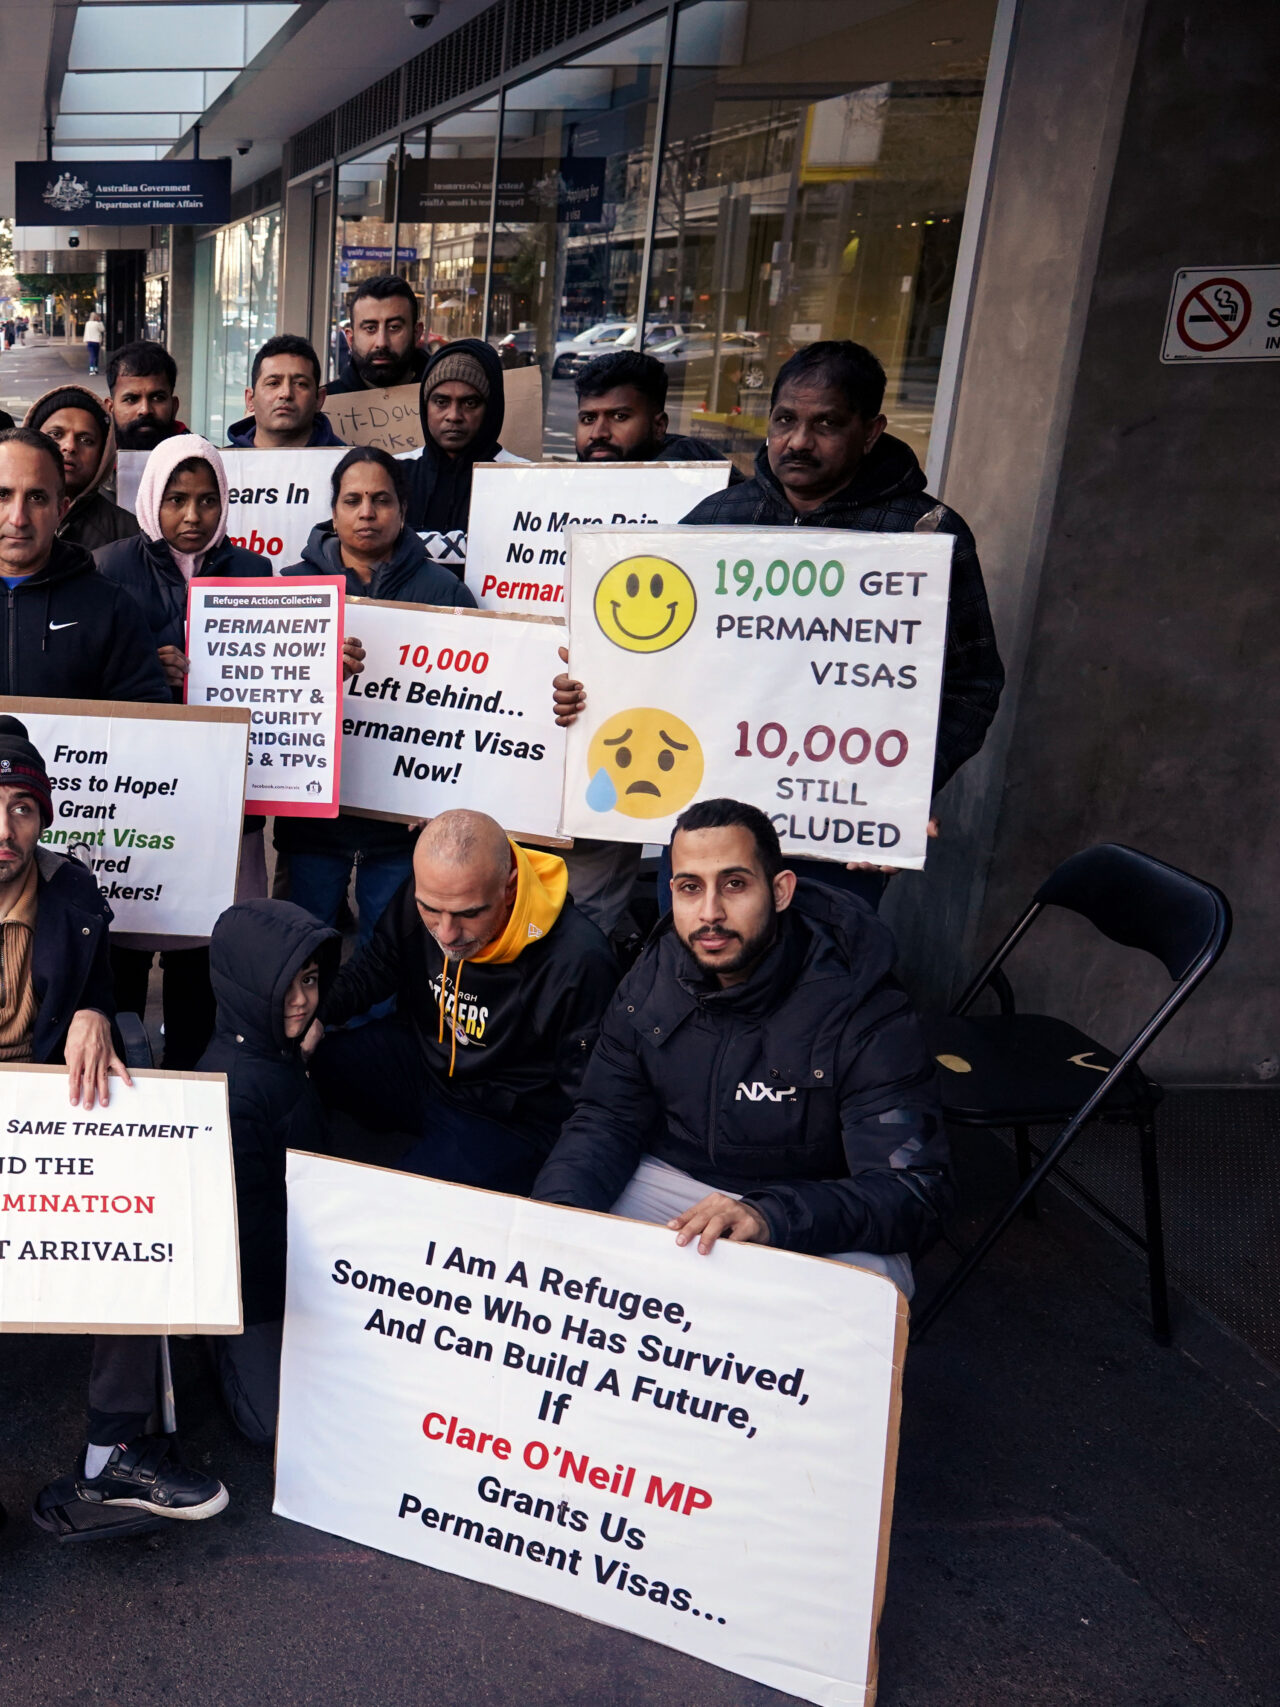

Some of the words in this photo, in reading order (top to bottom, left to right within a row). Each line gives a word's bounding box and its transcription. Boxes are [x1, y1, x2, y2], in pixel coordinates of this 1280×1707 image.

[95, 184, 138, 193] Australian
[140, 184, 191, 193] Government
[95, 200, 141, 210] Department
[142, 200, 151, 209] of
[152, 200, 175, 209] Home
[177, 200, 204, 209] Affairs
[286, 482, 309, 504] In
[512, 511, 542, 532] No
[506, 543, 535, 564] No
[714, 558, 845, 602] 19,000
[859, 571, 929, 597] GET
[213, 597, 250, 606] Refugee
[251, 596, 280, 605] Action
[280, 596, 323, 605] Collective
[204, 619, 332, 635] PERMANENT
[716, 614, 923, 645] PERMANENT
[207, 642, 267, 657] VISAS
[272, 642, 327, 657] NOW!
[399, 643, 490, 675] 10,000
[221, 665, 264, 680] END
[271, 666, 311, 681] THE
[810, 661, 919, 690] VISAS
[206, 687, 304, 703] POVERTY
[310, 689, 325, 704] &
[348, 675, 401, 703] Left
[406, 681, 524, 717] Behind...
[53, 745, 109, 765] From
[474, 729, 547, 761] Visas
[734, 720, 909, 768] 10,000
[260, 753, 274, 767] &
[280, 754, 327, 768] TPVs
[392, 755, 463, 785] Now!
[88, 775, 109, 793] to
[114, 775, 179, 799] Hope!
[775, 777, 869, 806] STILL
[58, 800, 117, 820] Grant
[113, 828, 176, 850] Visas
[766, 811, 901, 848] CLUDED
[6, 1119, 66, 1136] SAME
[73, 1121, 199, 1140] TREATMENT
[35, 1157, 95, 1176] THE
[18, 1240, 175, 1263] ARRIVALS!
[424, 1241, 437, 1266] I
[443, 1246, 497, 1281] Am
[505, 1262, 530, 1289] A
[540, 1269, 694, 1333] Refugee,
[331, 1259, 473, 1315] Someone
[482, 1296, 553, 1335] Who
[560, 1315, 628, 1355] Has
[637, 1336, 812, 1406] Survived,
[364, 1308, 427, 1345] And
[433, 1326, 494, 1363] Can
[502, 1342, 589, 1387] Build
[594, 1368, 621, 1397] A
[631, 1377, 760, 1440] Future,
[536, 1389, 572, 1426] If
[421, 1411, 513, 1461] Clare
[522, 1440, 636, 1498] O’Neil
[645, 1478, 714, 1518] MP
[476, 1475, 589, 1534] Grants
[599, 1514, 648, 1552] Us
[397, 1494, 582, 1577] Permanent
[592, 1554, 728, 1627] Visas...
